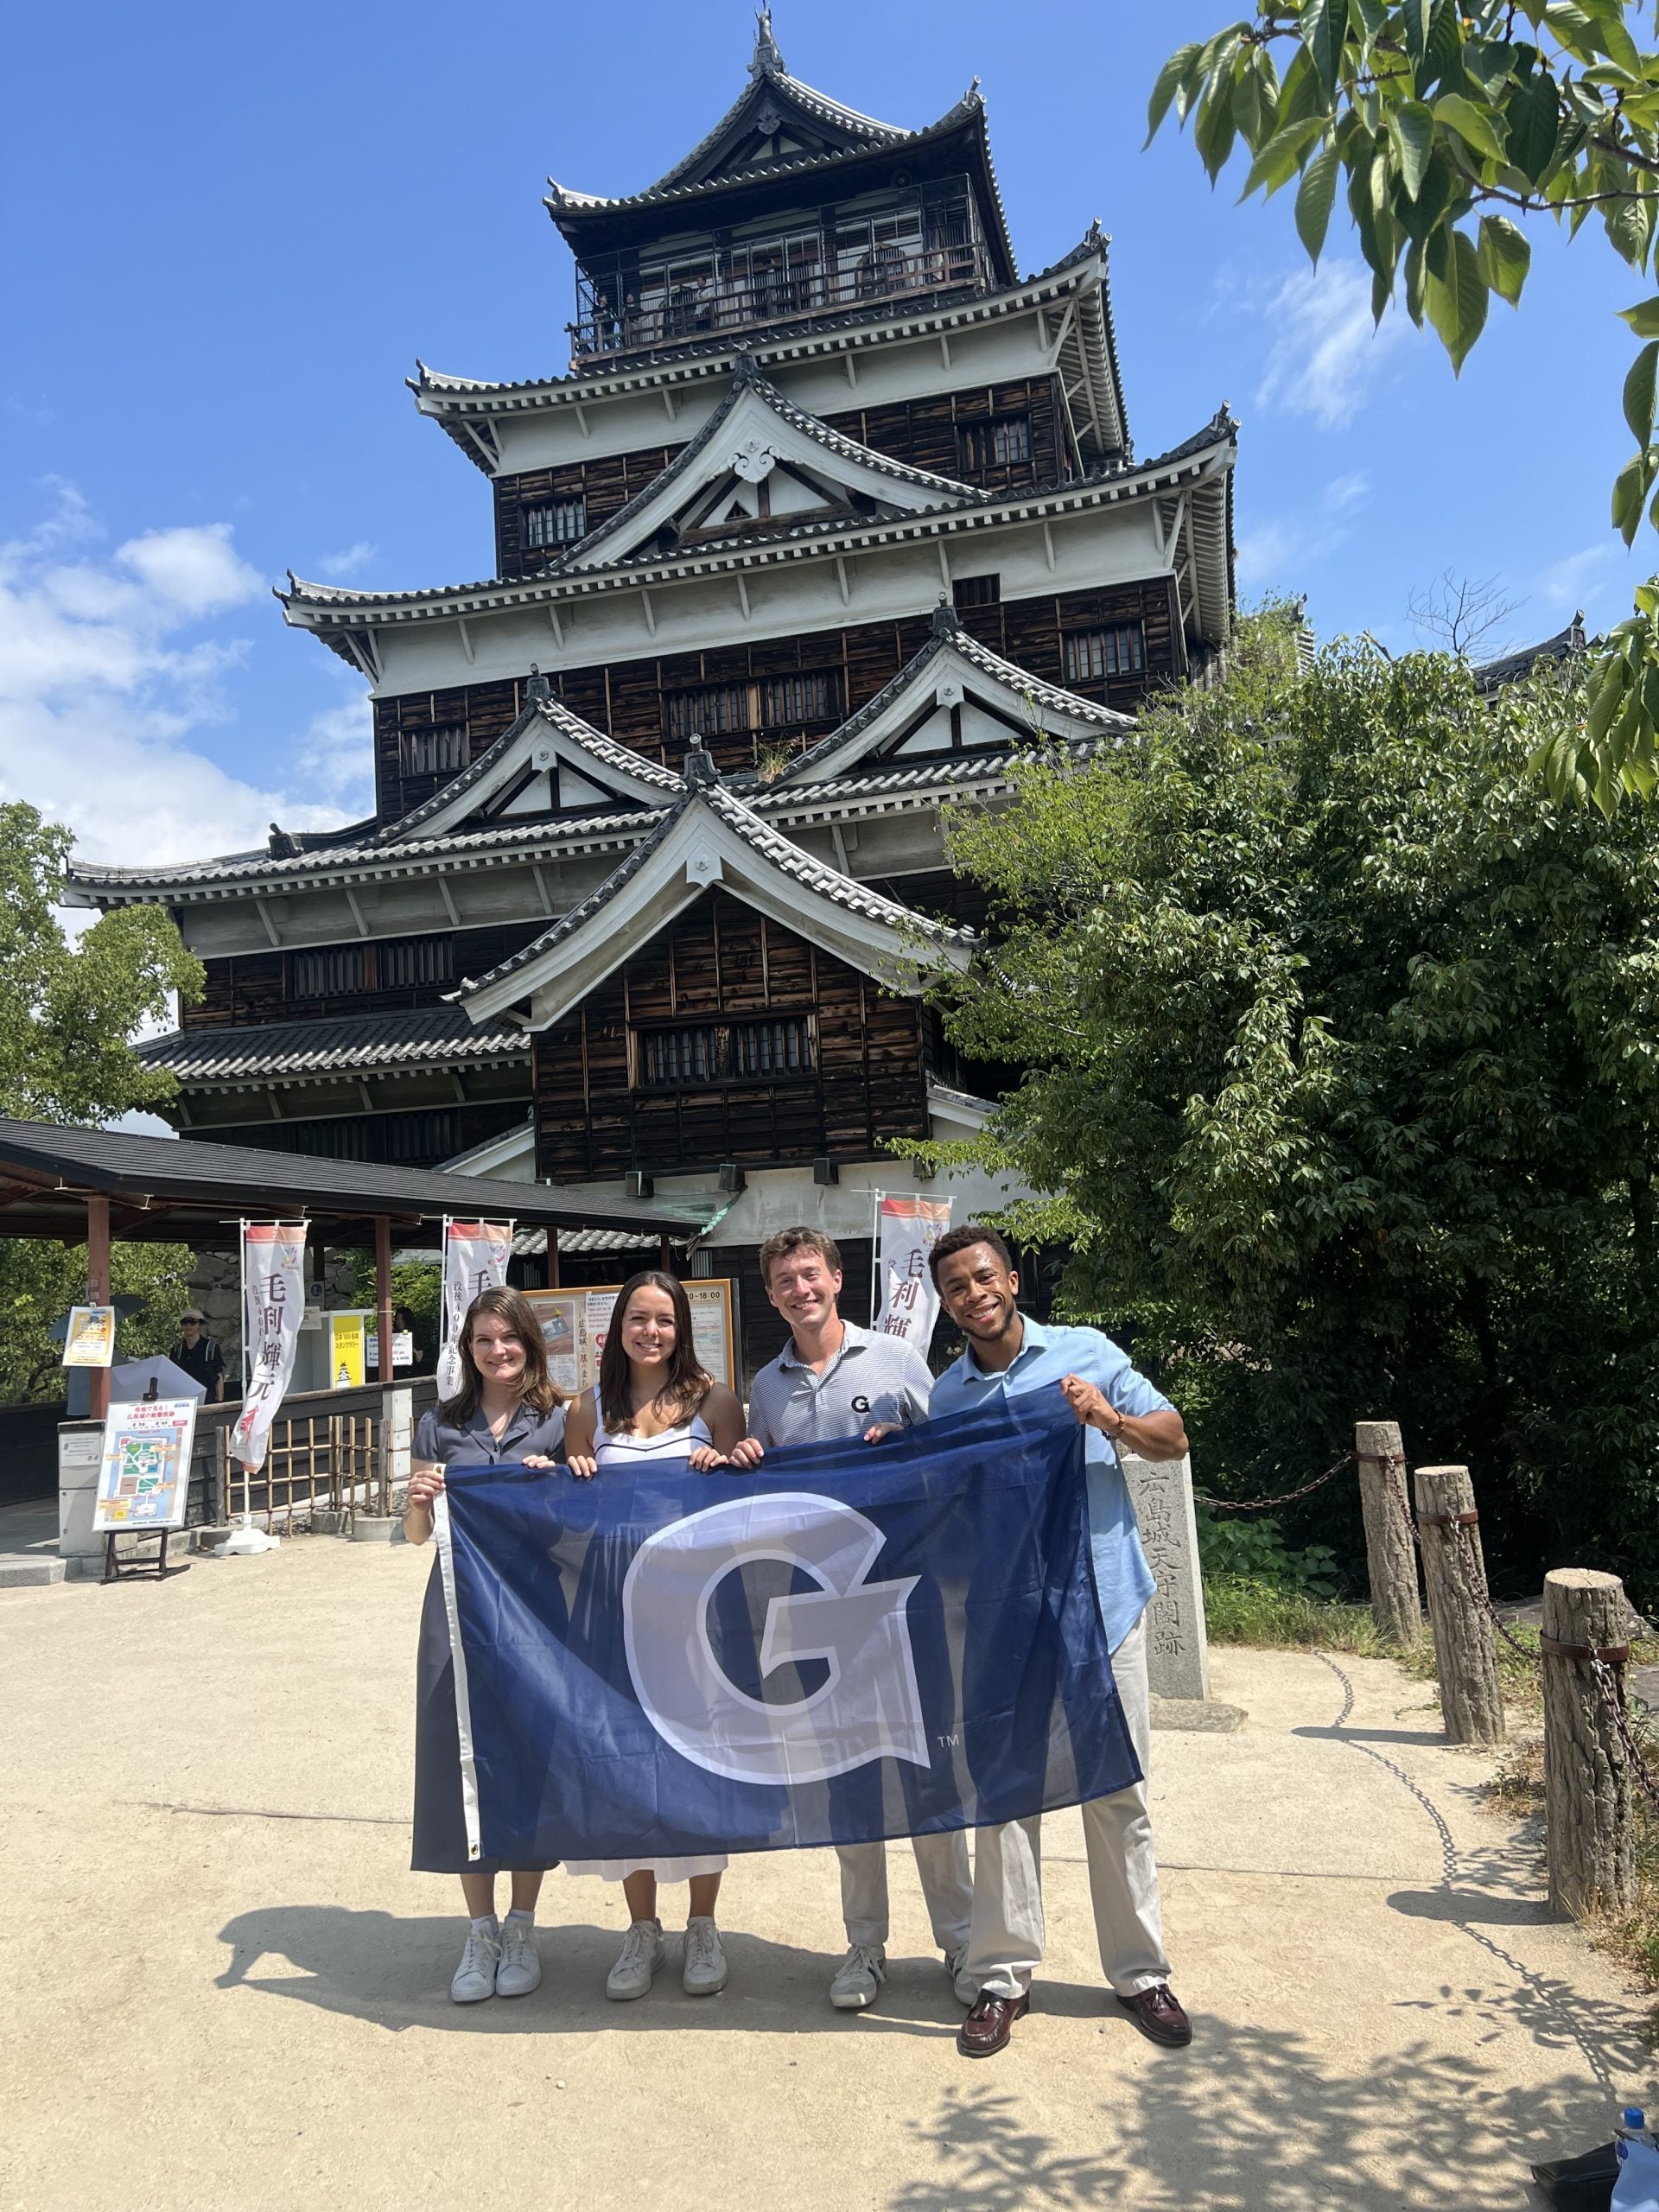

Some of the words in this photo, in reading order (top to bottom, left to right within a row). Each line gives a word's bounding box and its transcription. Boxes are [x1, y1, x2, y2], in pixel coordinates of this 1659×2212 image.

[247, 1273, 287, 1401] 毛利輝元
[446, 1281, 464, 1386] 没後400年記念事業
[851, 1395, 870, 1414] G
[622, 1492, 931, 1785] G
[937, 1734, 960, 1748] TM
